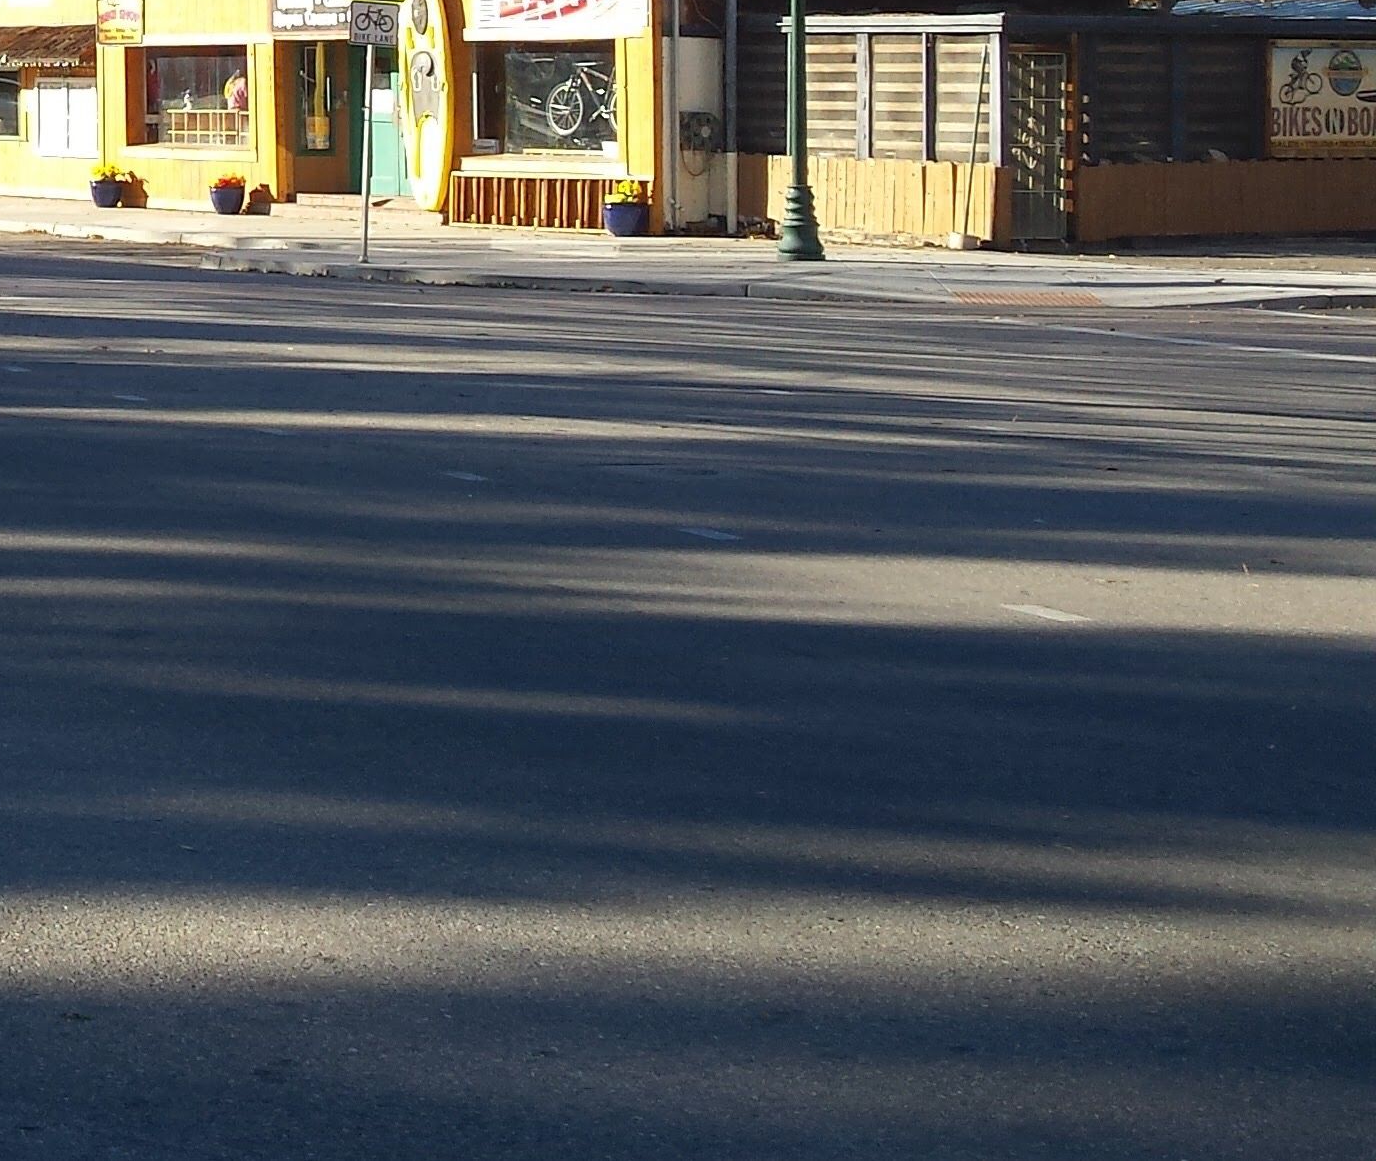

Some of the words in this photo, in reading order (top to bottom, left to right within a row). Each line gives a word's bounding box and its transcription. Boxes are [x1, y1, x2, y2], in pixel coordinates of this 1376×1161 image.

[353, 32, 374, 42] BIKE
[374, 33, 394, 43] LANE
[1270, 106, 1323, 137] BIKES
